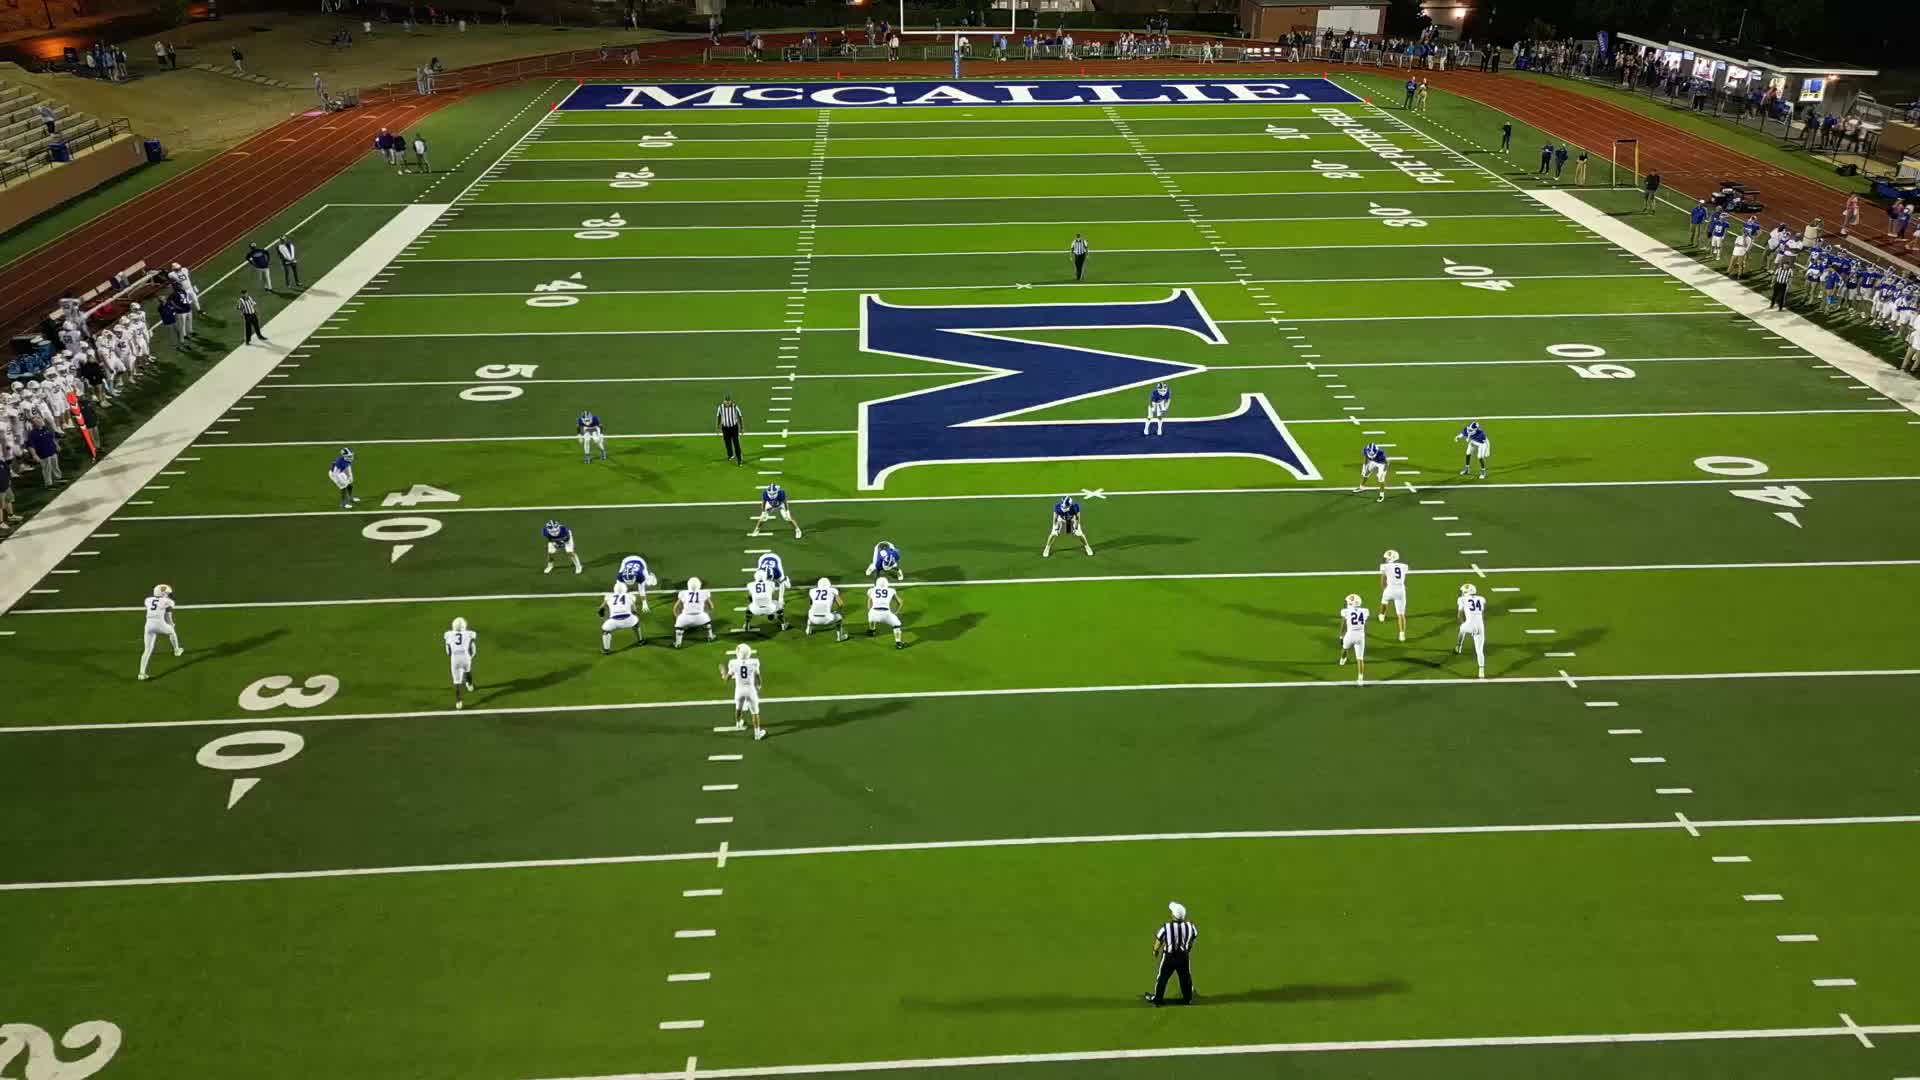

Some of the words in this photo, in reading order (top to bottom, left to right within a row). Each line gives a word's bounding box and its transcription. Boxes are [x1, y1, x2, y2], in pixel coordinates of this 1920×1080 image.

[1311, 107, 1364, 127] FIELD
[637, 135, 679, 148] 10
[1342, 128, 1415, 159] POTTER
[608, 171, 656, 189] 20
[1390, 160, 1455, 184] PETE
[1368, 207, 1428, 228] 30
[573, 218, 627, 240] 30
[1443, 265, 1515, 292] 40
[525, 279, 588, 308] 40
[1545, 343, 1637, 380] 50
[458, 363, 540, 402] 50
[857, 287, 1324, 491] M
[1693, 455, 1814, 508] 40
[361, 483, 462, 541] 40
[1394, 567, 1402, 579] 9
[688, 591, 700, 604] 71
[755, 583, 767, 594] 61
[815, 589, 828, 601] 72
[875, 588, 889, 599] 59
[150, 599, 160, 611] 5
[612, 594, 627, 606] 74
[1468, 599, 1482, 612] 34
[1350, 612, 1365, 625] 24
[455, 633, 463, 646] 3
[740, 665, 748, 679] 8
[195, 674, 340, 771] 30
